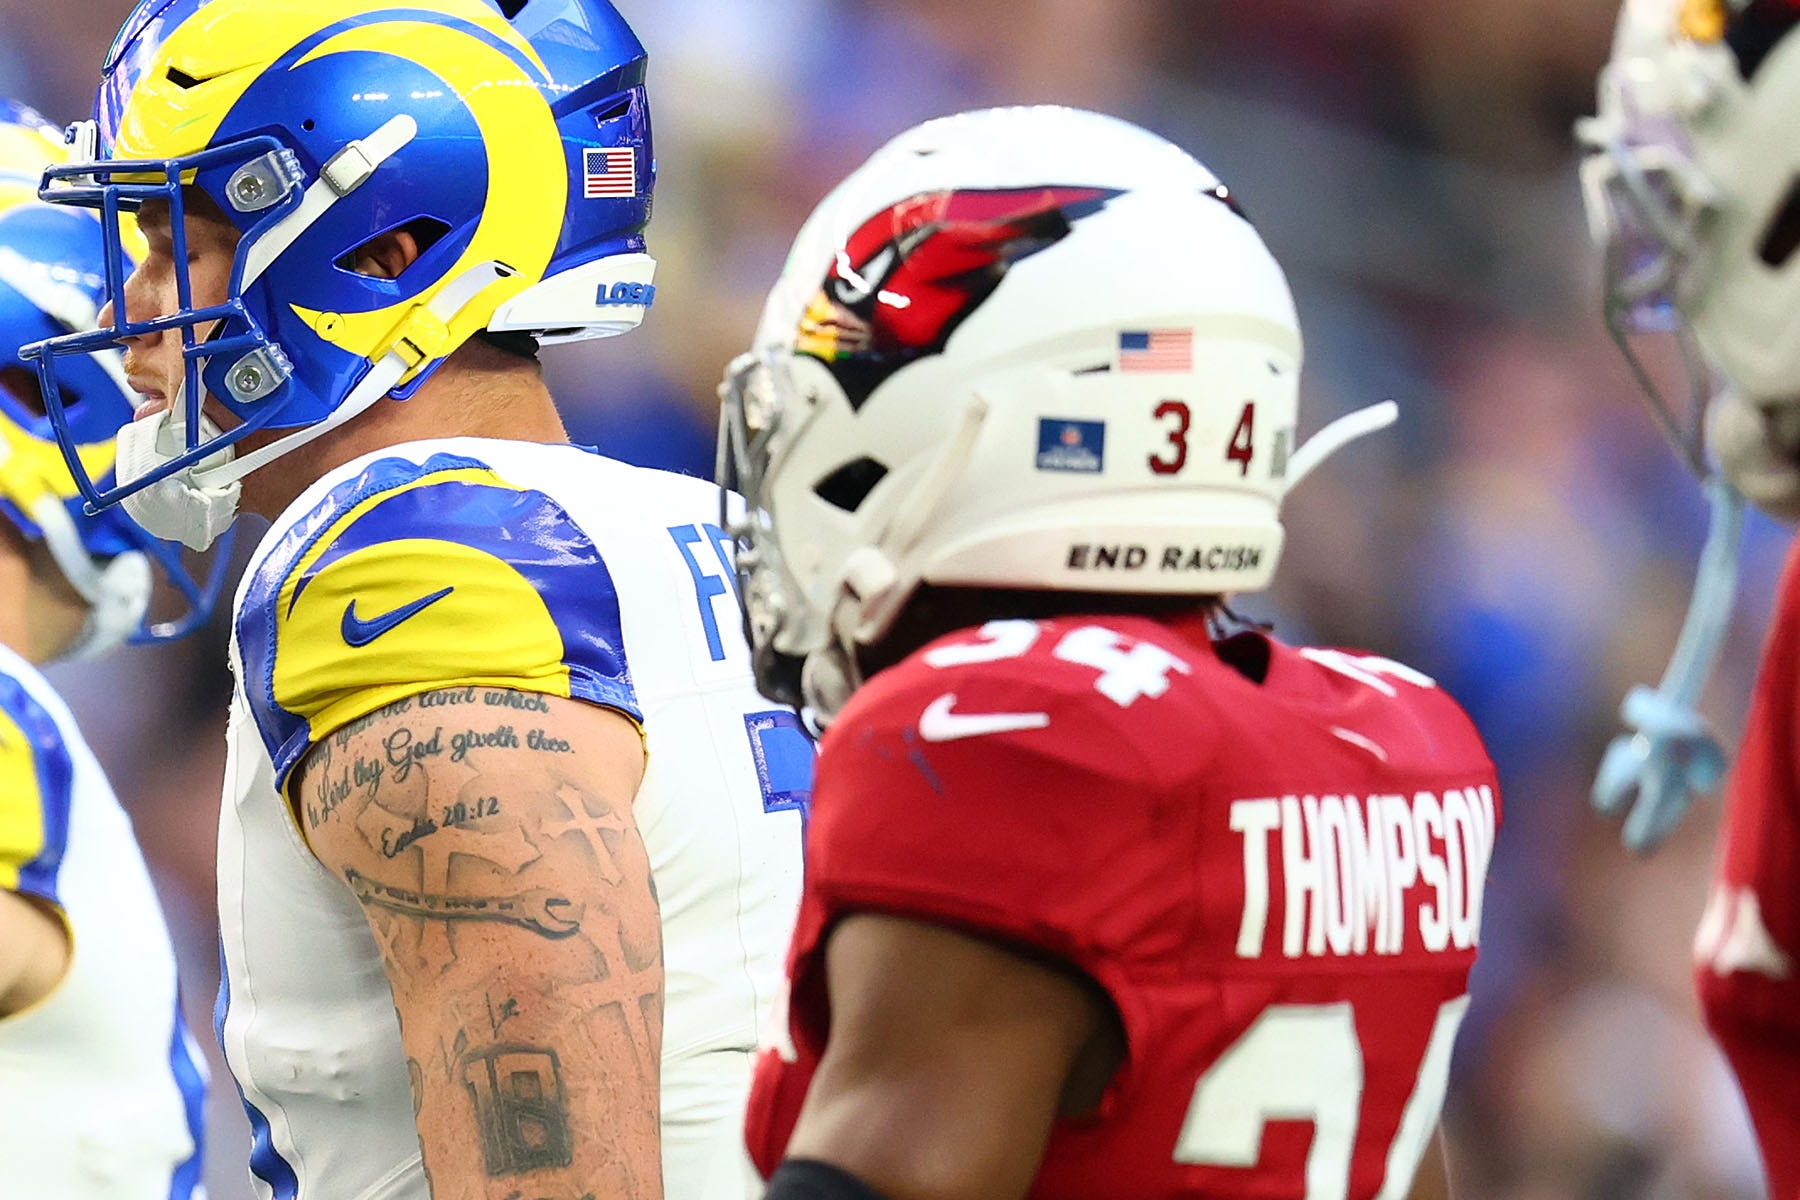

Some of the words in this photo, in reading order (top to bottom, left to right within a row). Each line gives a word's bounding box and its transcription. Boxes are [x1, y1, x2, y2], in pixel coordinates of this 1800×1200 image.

[1067, 545, 1148, 570] END
[1158, 546, 1263, 571] RACISM
[484, 689, 550, 714] which
[382, 727, 444, 784] God
[450, 725, 520, 763] giveth
[442, 796, 500, 828] 20:12
